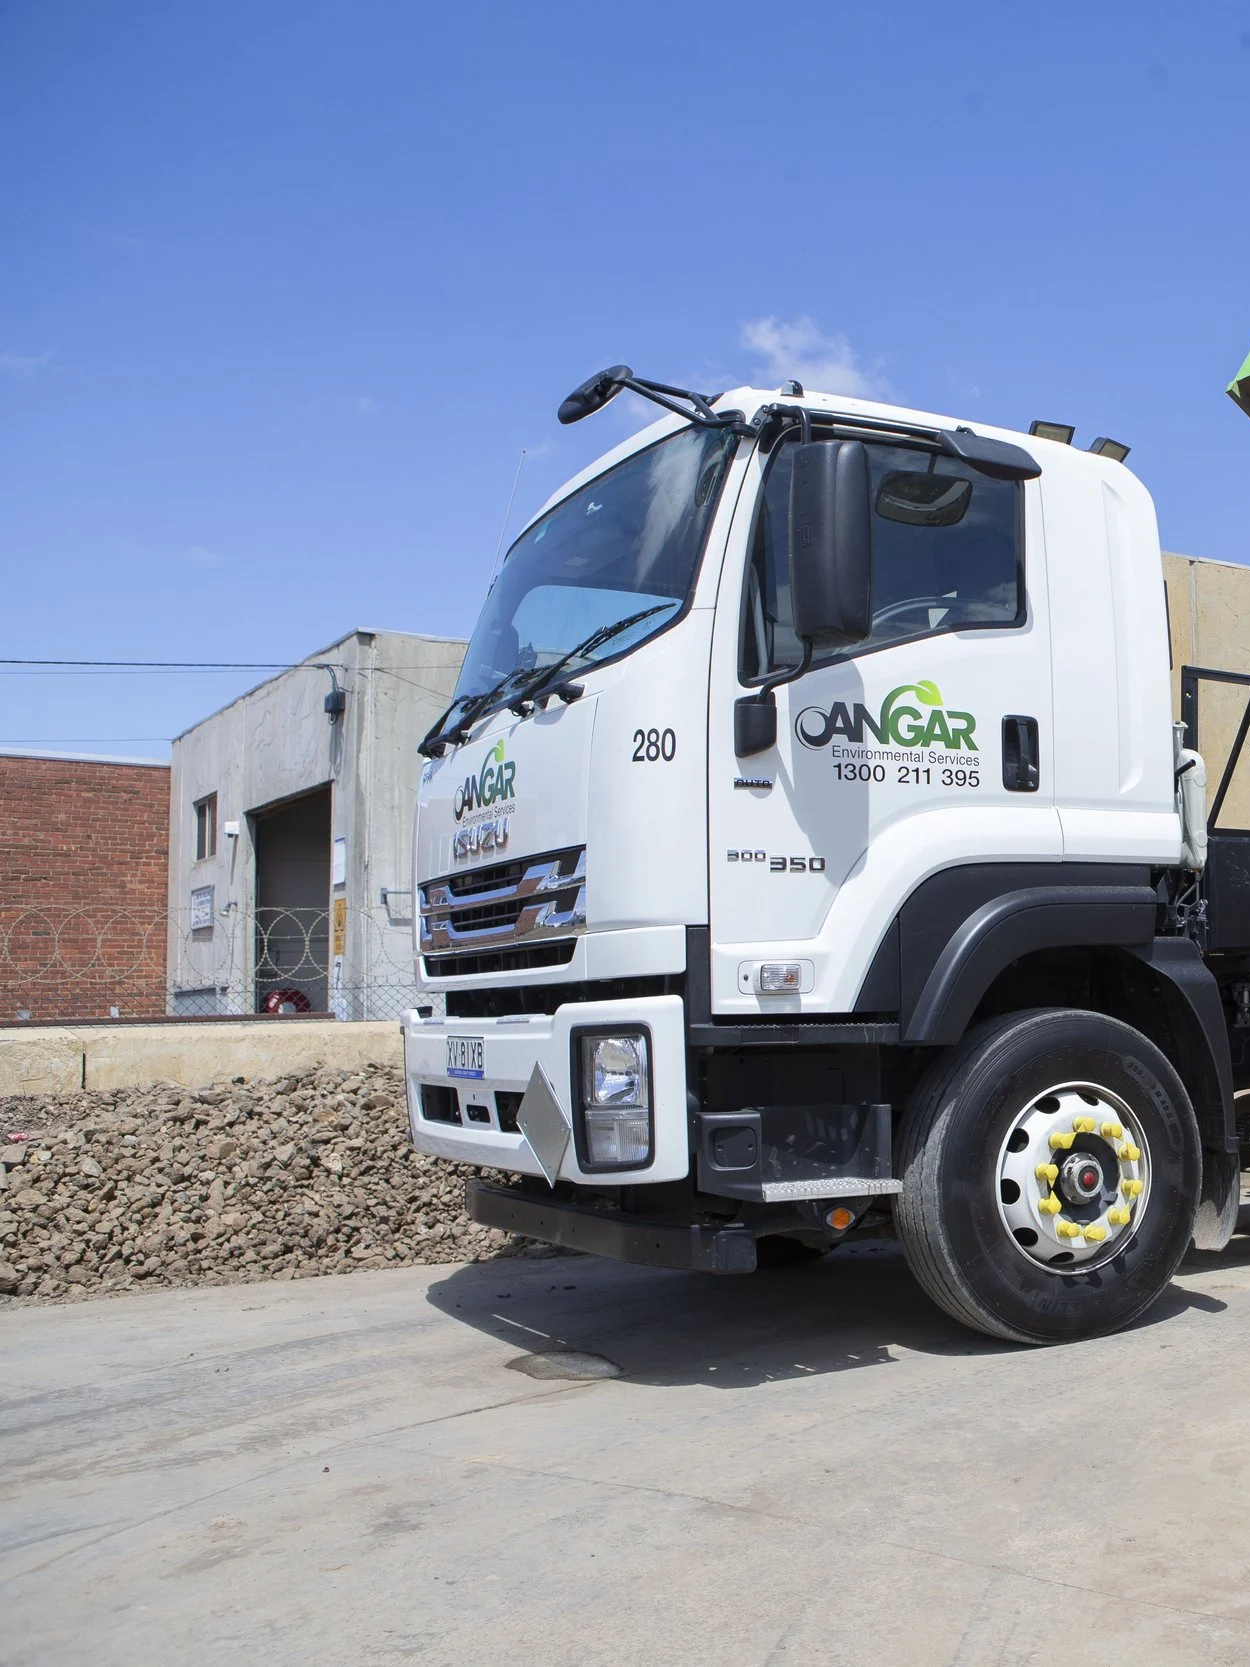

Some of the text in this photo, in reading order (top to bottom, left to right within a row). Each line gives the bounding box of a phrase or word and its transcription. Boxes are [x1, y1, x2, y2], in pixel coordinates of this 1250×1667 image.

[632, 728, 676, 762] 280
[832, 745, 980, 767] Environmental Services
[833, 763, 980, 788] 1300 211 395
[493, 803, 516, 818] Services
[453, 817, 509, 861] ISUZU
[769, 856, 825, 873] 350
